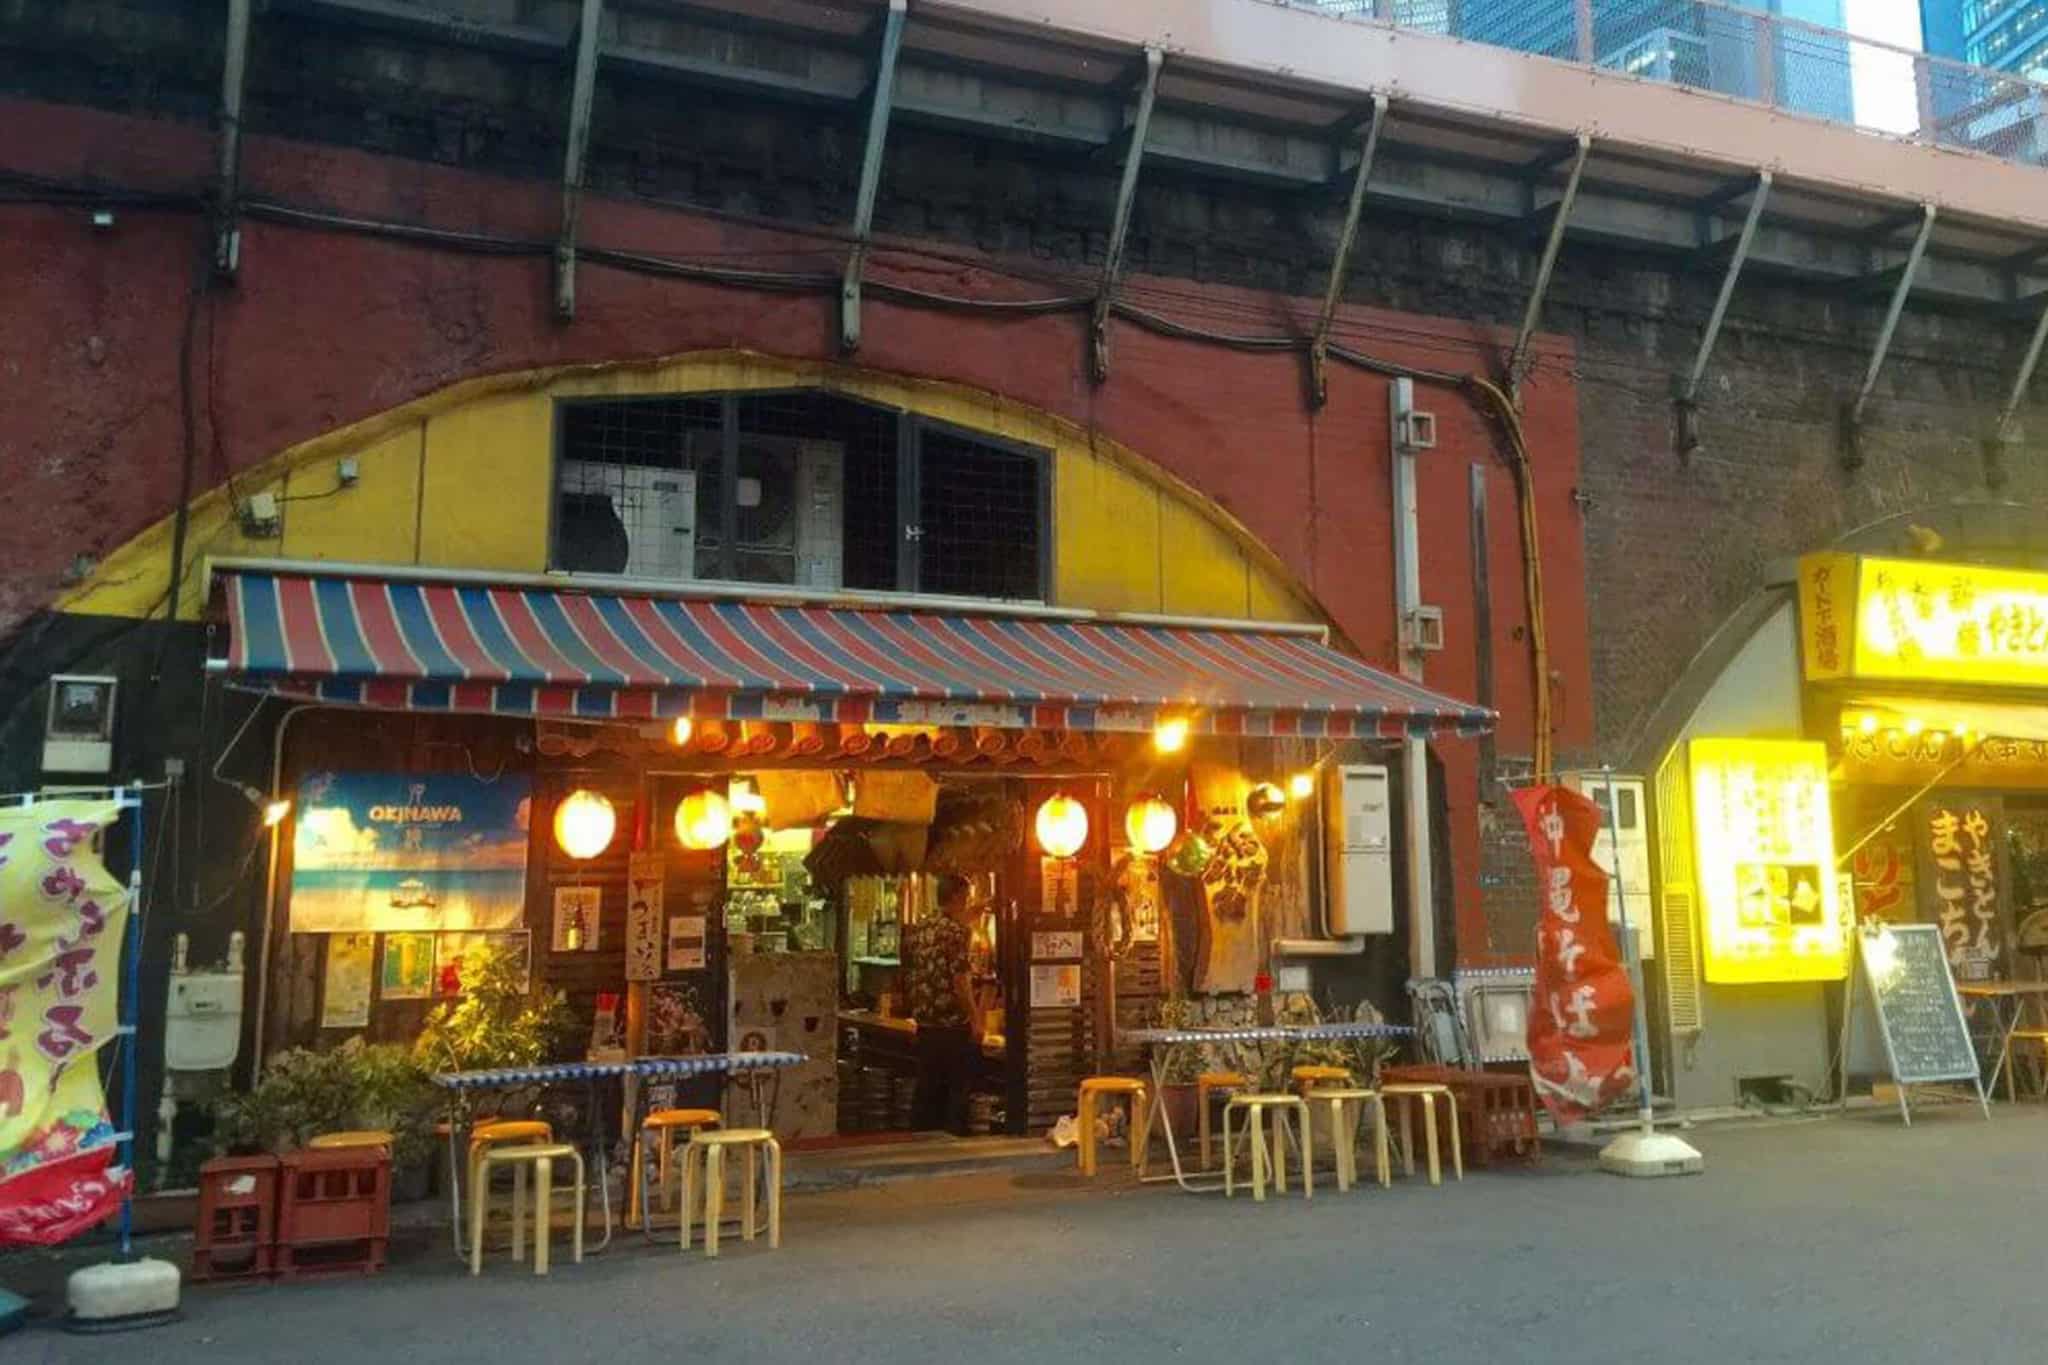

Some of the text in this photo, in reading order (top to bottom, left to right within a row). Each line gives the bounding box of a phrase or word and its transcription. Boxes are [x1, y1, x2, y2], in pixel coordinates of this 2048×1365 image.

[368, 804, 463, 824] OKINAWA
[1961, 808, 2001, 961] やきとん
